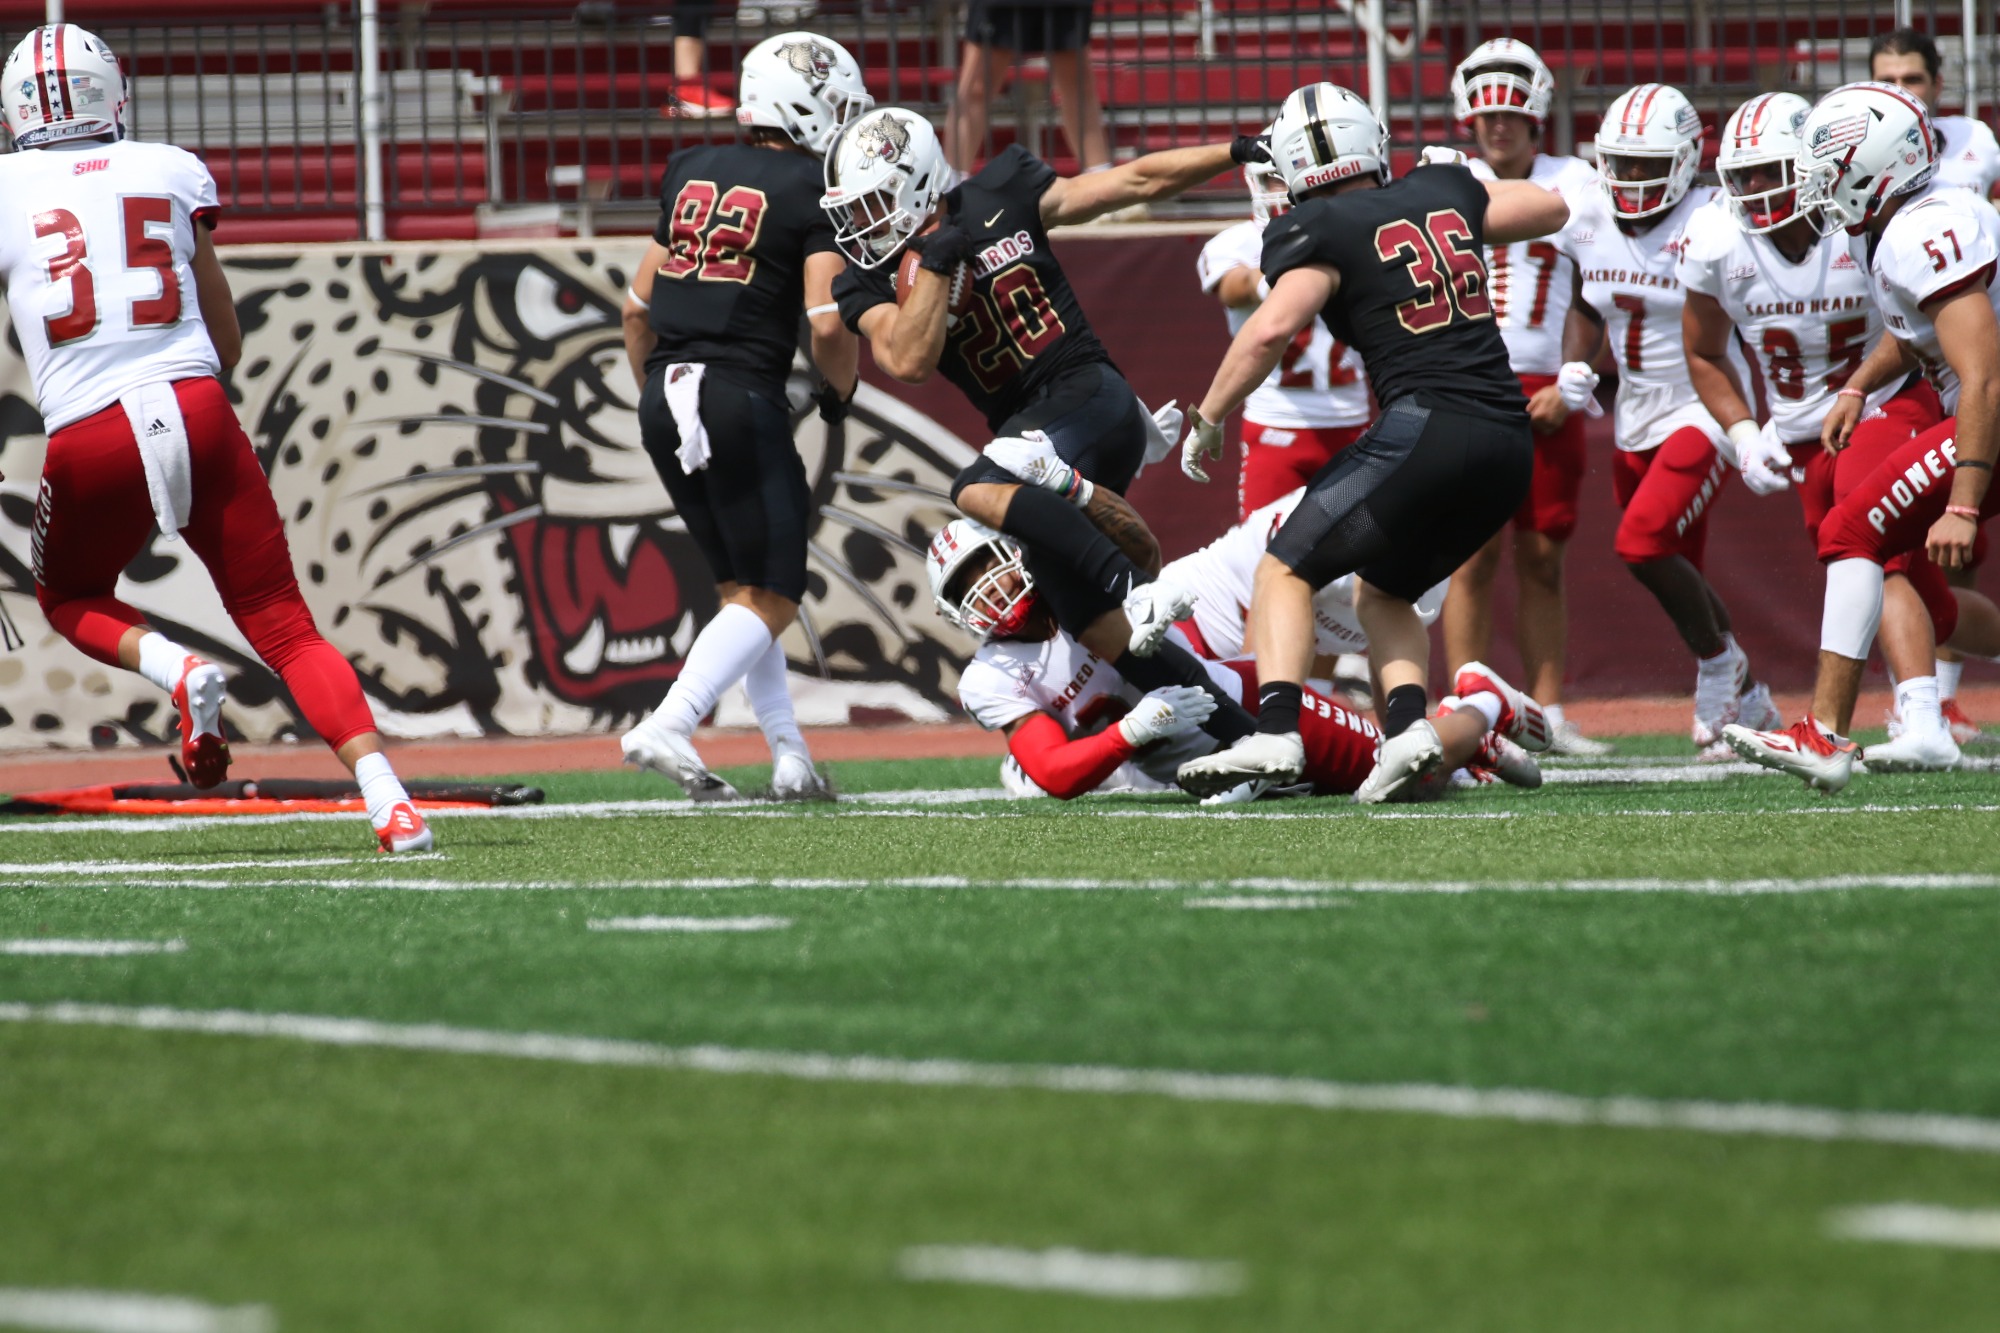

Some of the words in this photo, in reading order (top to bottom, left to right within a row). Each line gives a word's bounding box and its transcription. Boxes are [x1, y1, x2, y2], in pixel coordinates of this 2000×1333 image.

[29, 127, 63, 141] SACRED
[73, 159, 110, 176] SHU
[1304, 160, 1362, 188] Riddell
[658, 179, 768, 285] 82
[1922, 227, 1964, 275] 57
[27, 193, 182, 348] 35
[1373, 207, 1492, 335] 36
[1491, 240, 1559, 328] 17
[1583, 267, 1627, 283] SACRED
[1630, 270, 1680, 291] HEART
[949, 262, 1066, 394] 20
[1745, 302, 1805, 317] SACRED
[1810, 296, 1864, 314] HEART
[1611, 290, 1648, 374] 7
[1761, 313, 1870, 401] 85
[146, 427, 171, 438] adidas
[1051, 663, 1095, 712] SACRED
[1150, 716, 1178, 728] adidas
